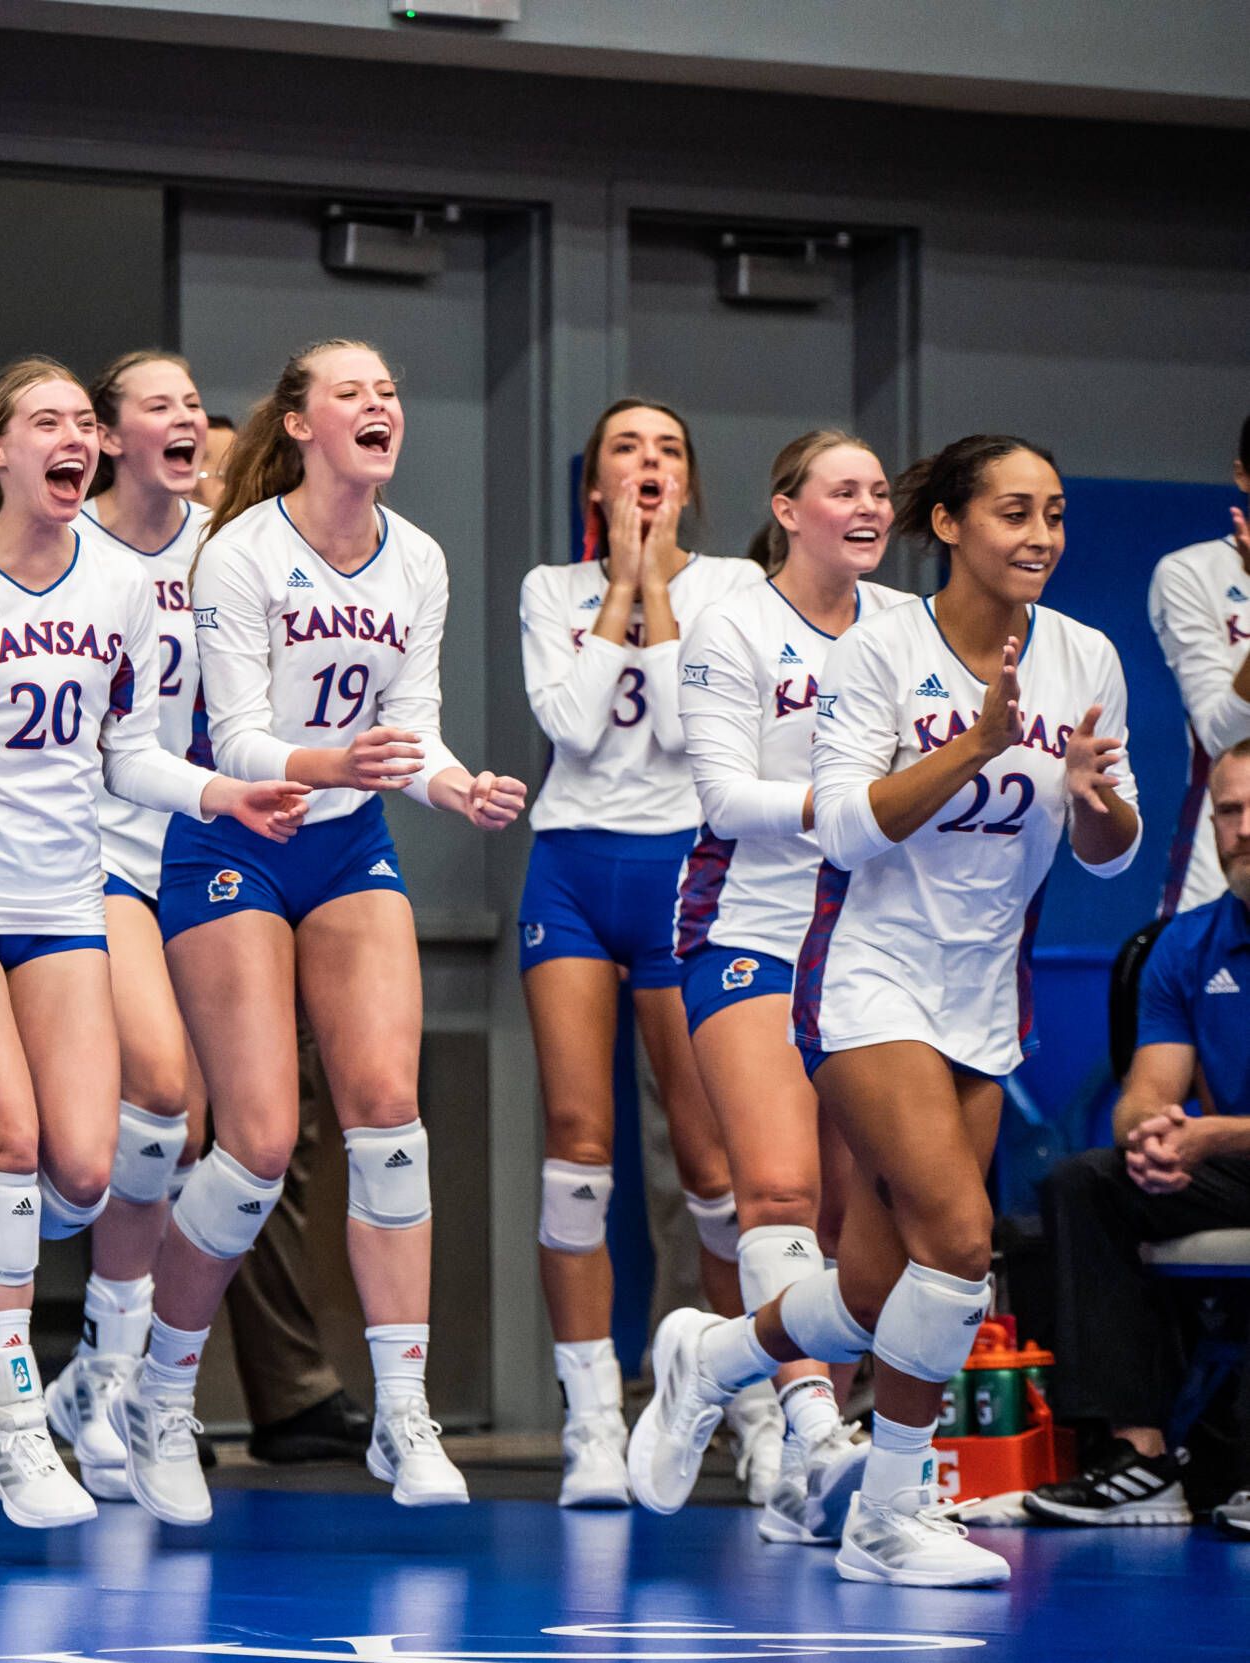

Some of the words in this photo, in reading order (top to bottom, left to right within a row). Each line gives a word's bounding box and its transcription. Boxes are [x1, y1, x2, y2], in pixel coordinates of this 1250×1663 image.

[5, 680, 82, 749] 20
[305, 662, 369, 729] 19
[613, 667, 646, 728] 3
[937, 772, 1035, 835] 22
